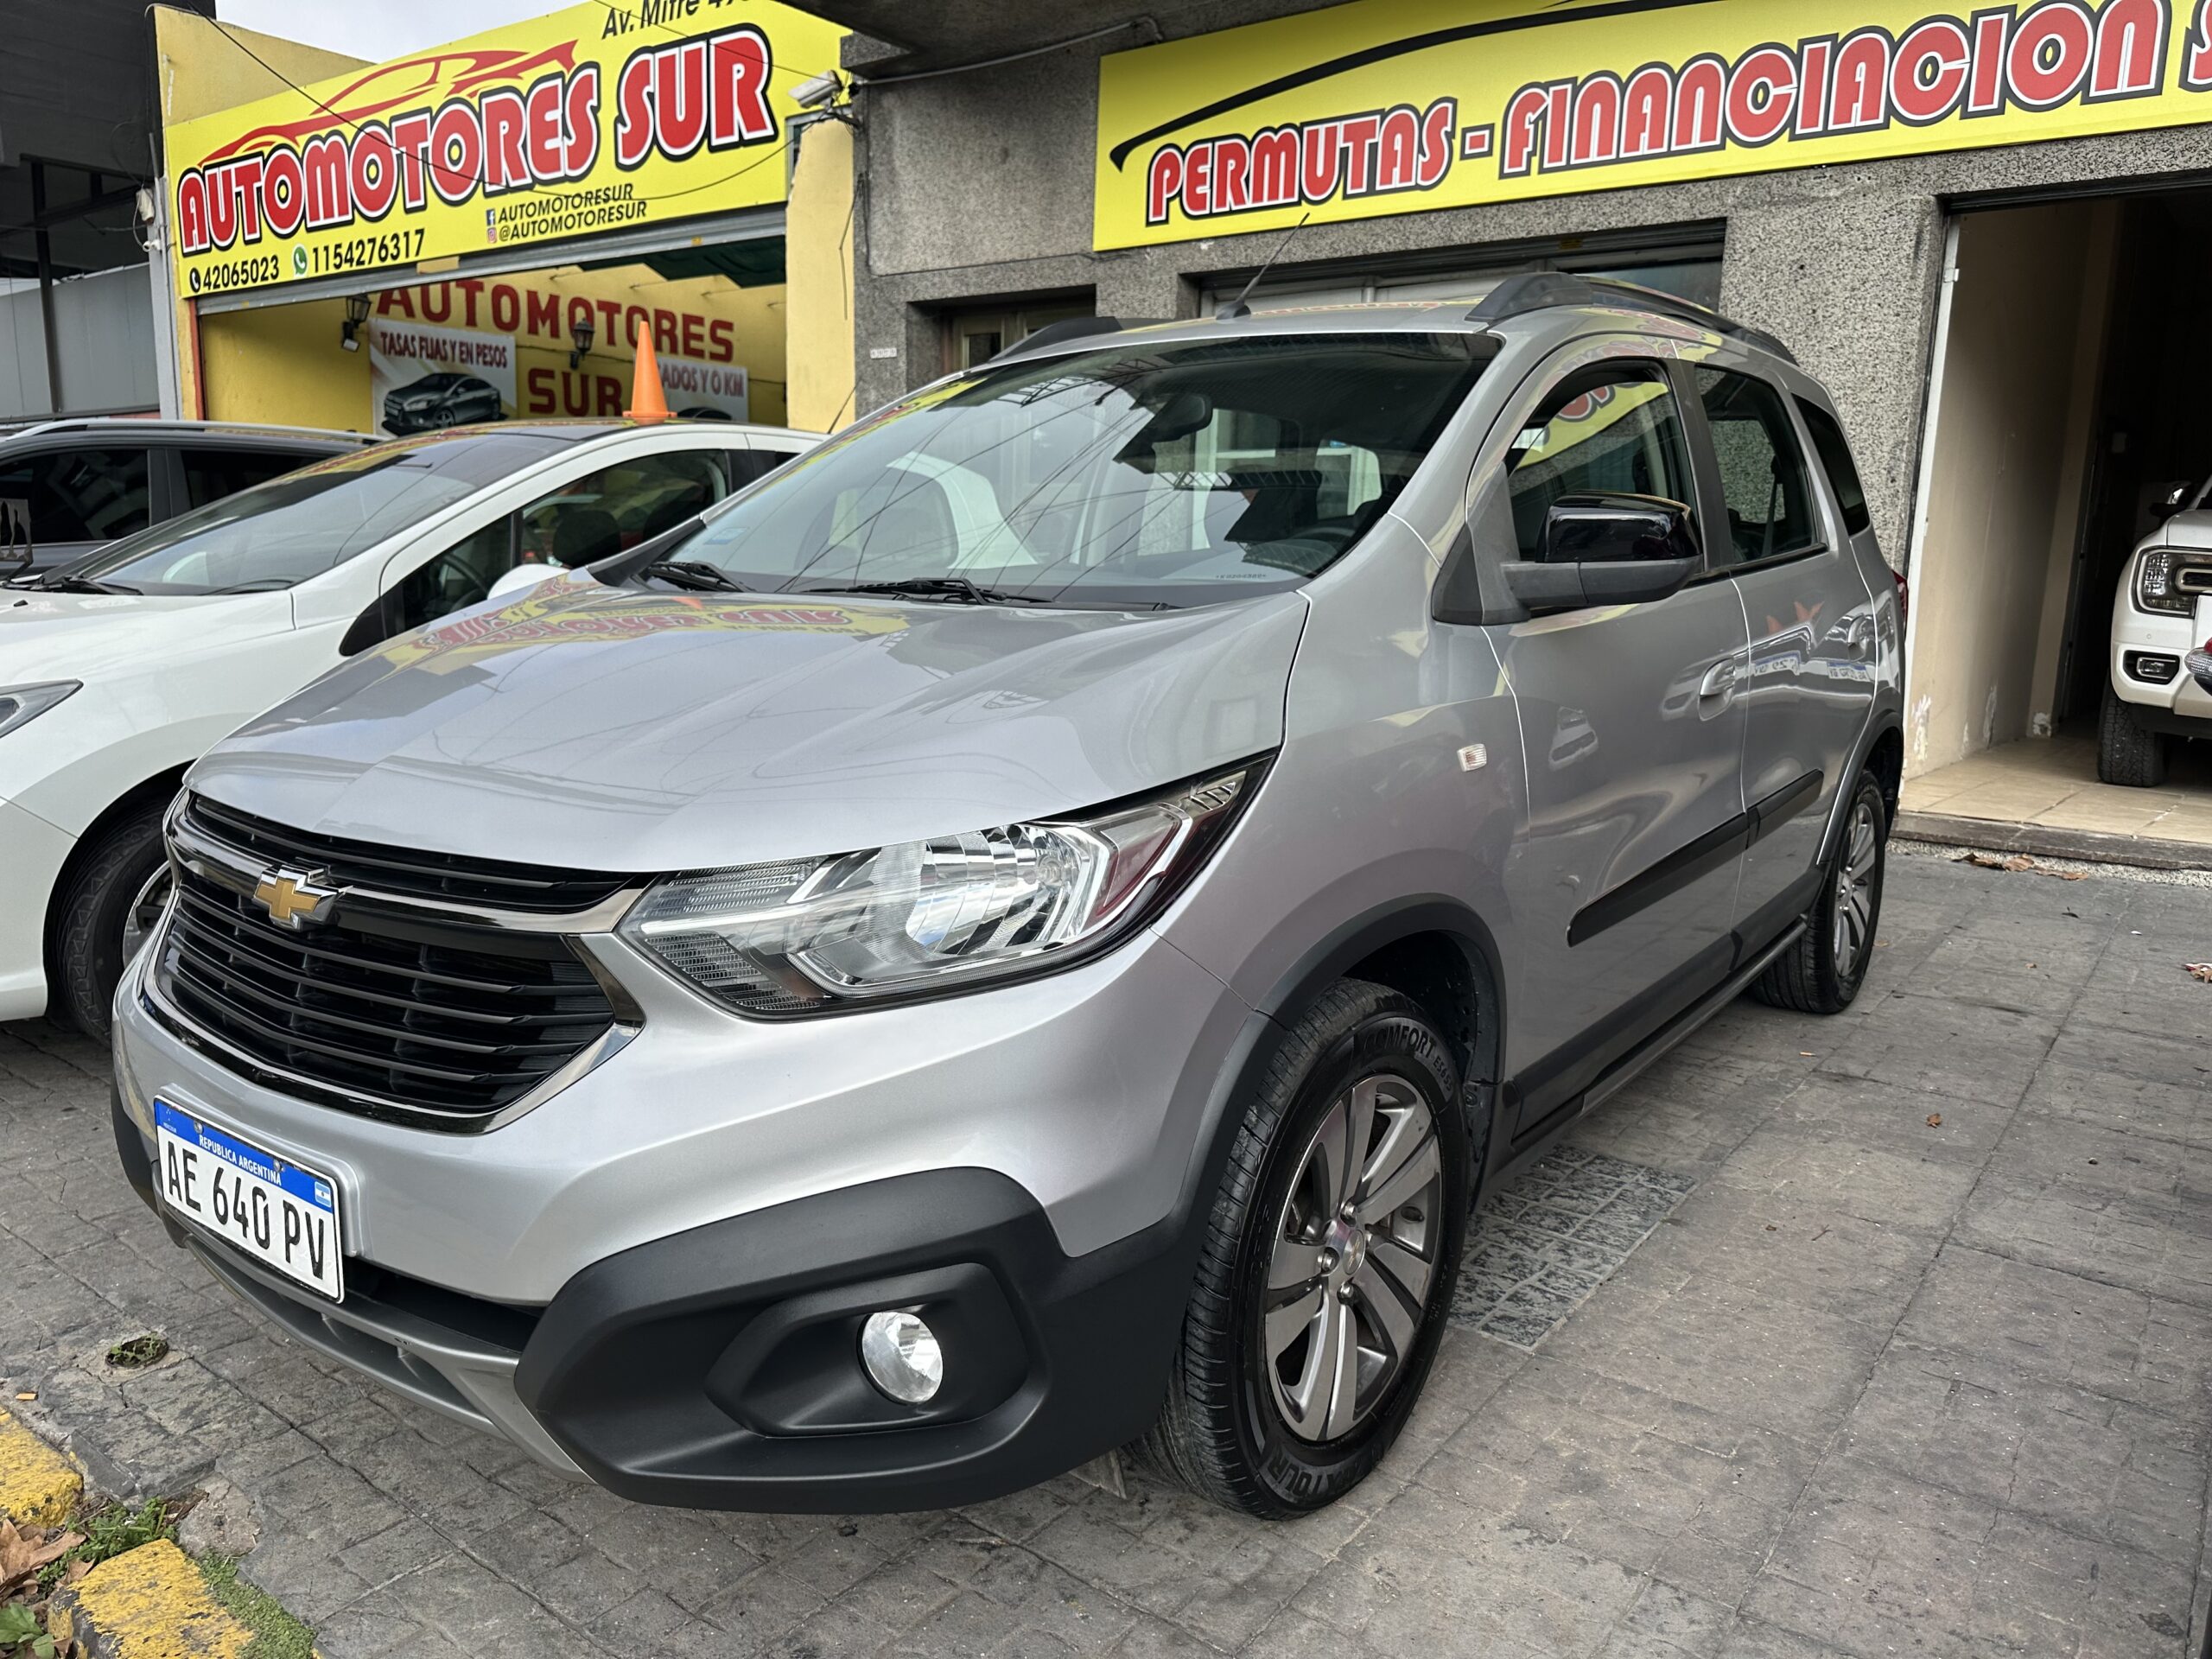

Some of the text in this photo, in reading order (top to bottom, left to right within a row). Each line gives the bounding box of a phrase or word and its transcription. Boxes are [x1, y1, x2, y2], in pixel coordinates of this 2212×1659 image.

[601, 7, 634, 40] Av.
[1147, 97, 1457, 226] PERMUTAS
[1499, 0, 2171, 179] FINANCIACION
[178, 23, 778, 257] AUTOMOTORES SUR
[498, 183, 633, 224] AUTOMOTORESUR
[499, 200, 647, 241] @AUTOMOTORESUR
[203, 255, 279, 291] 42065023
[313, 228, 425, 273] 1154276317
[377, 280, 734, 363] AUTOMOTORES
[380, 331, 416, 358] TASAS
[449, 339, 457, 362] Y
[459, 341, 474, 365] EN
[476, 343, 508, 369] PESOS
[528, 368, 622, 416] SUR
[658, 363, 697, 393] ADOS
[700, 368, 709, 393] Y
[724, 372, 744, 397] KM
[199, 1134, 282, 1186] REPUBLICA ARGENTINA
[168, 1141, 325, 1280] AE 640 PV
